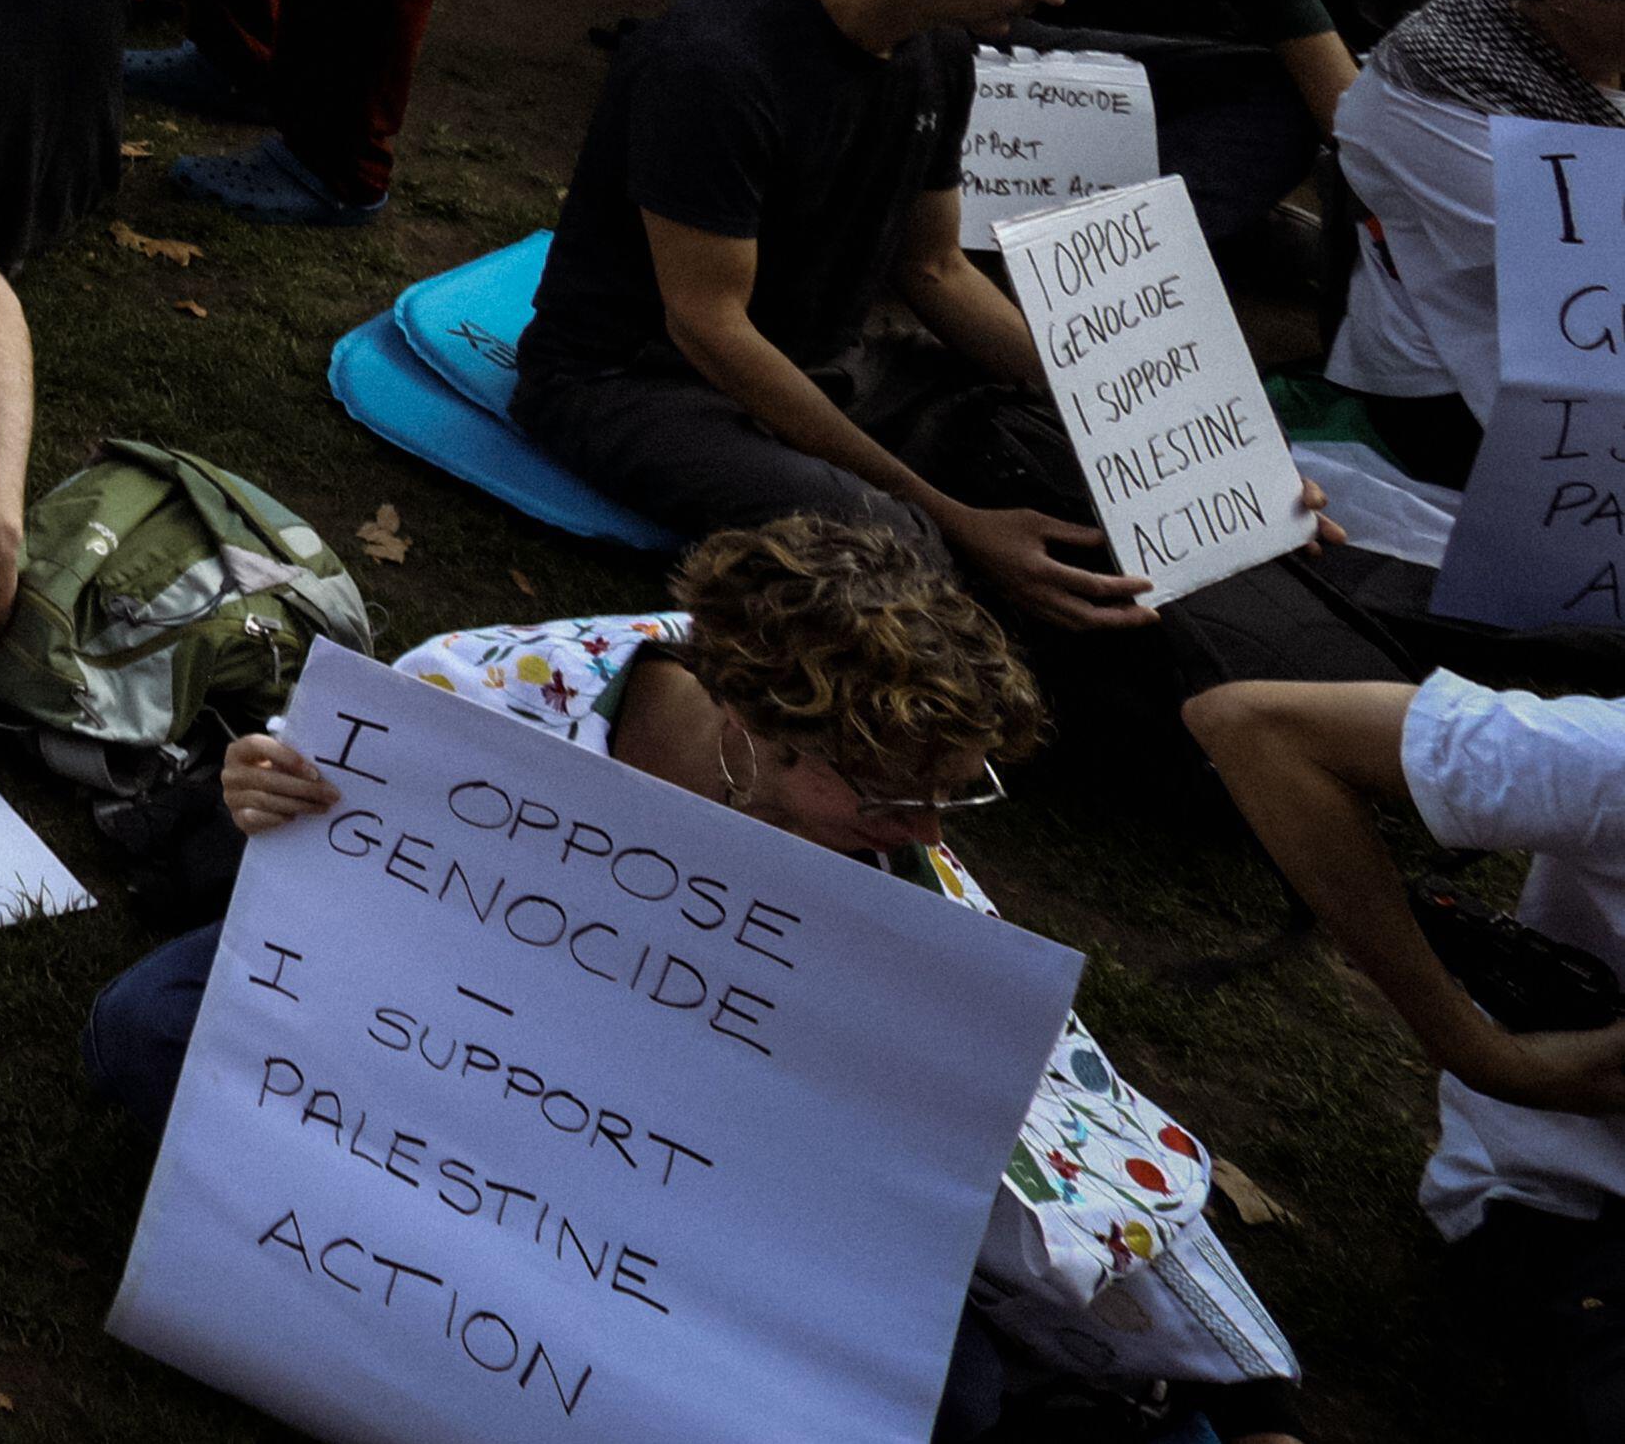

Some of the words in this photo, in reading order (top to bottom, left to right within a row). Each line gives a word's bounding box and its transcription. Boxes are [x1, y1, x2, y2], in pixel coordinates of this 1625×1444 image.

[1026, 79, 1132, 116] GENOCIDE
[1052, 202, 1162, 302] OPPOSE
[1044, 273, 1186, 370] GENOCIDE
[1097, 340, 1202, 415] SUPPORT
[1094, 397, 1259, 505] PALESTINE
[1129, 480, 1268, 571] ACTION
[447, 781, 802, 971] OPPOSE
[325, 808, 775, 1058] GENOCIDE
[369, 1004, 717, 1190] SUPPORT
[258, 1058, 671, 1314] PALESTINE
[258, 1211, 592, 1418] ACTION
